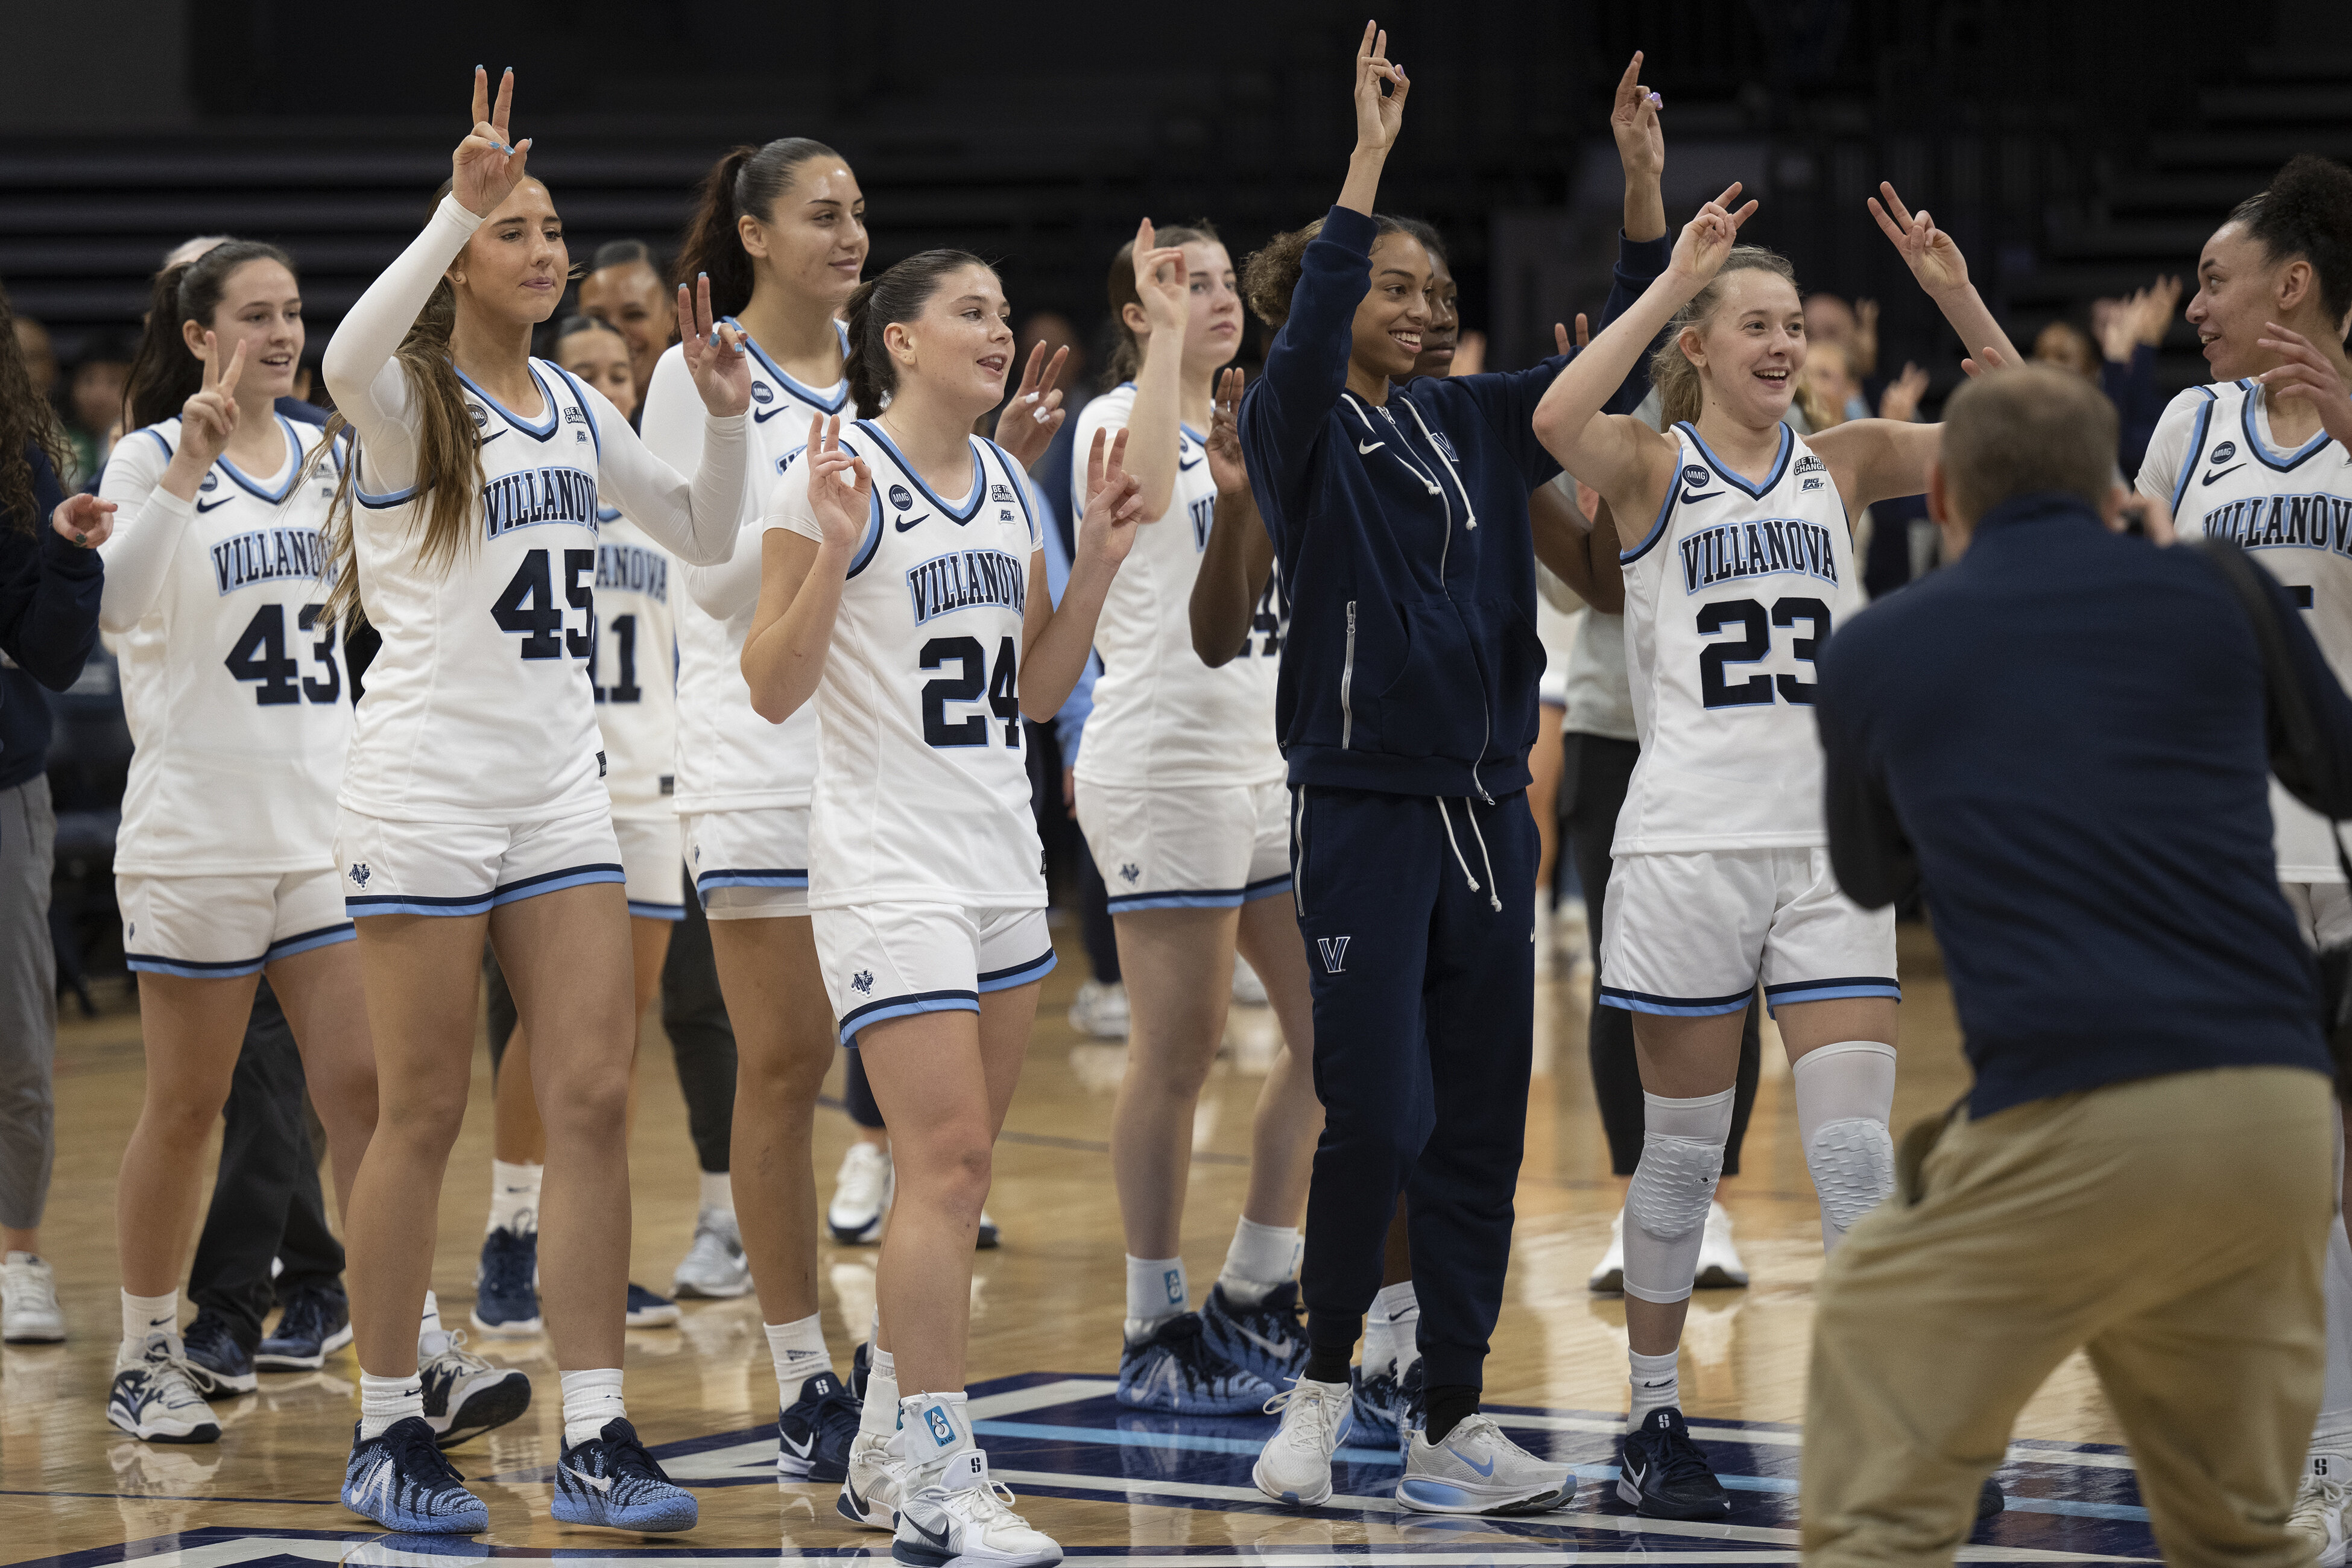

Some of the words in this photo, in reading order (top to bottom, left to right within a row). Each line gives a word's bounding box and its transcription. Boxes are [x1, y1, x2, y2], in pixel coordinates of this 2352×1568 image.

[754, 388, 771, 397] MMG
[564, 407, 575, 416] BE
[566, 414, 585, 423] CHAN
[2213, 446, 2232, 458] MMG
[1795, 457, 1807, 467] BE
[1687, 470, 1706, 480] MMG
[1794, 463, 1826, 475] CHANGE
[893, 492, 909, 502] MMG
[993, 493, 1015, 501] CHANG
[2202, 492, 2352, 560] VILLANOV
[1679, 518, 1838, 596] VILLANOVA
[906, 549, 1025, 627] VILLANOVA
[490, 549, 595, 661] 45
[224, 604, 340, 706] 43
[1696, 596, 1832, 710] 23
[919, 636, 1020, 750] 24
[1317, 936, 1351, 973] V
